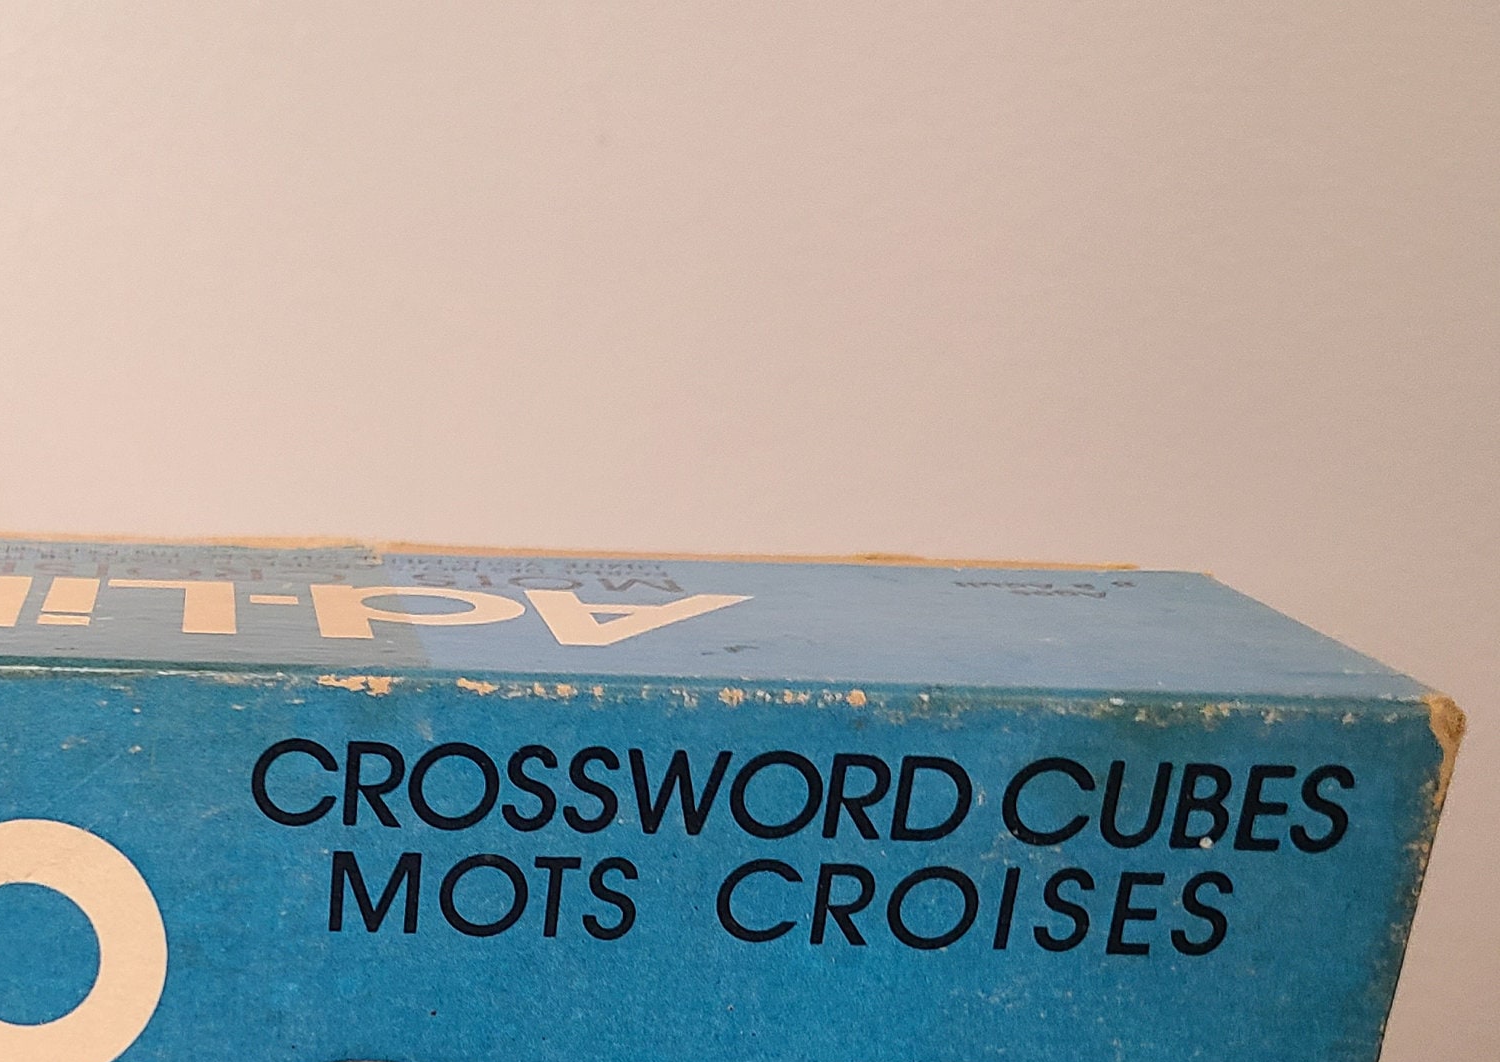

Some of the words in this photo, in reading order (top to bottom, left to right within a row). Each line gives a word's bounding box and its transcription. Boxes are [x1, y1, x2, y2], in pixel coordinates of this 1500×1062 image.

[251, 737, 973, 841] CROSSWORD
[1002, 756, 1355, 853] CUBES
[328, 851, 639, 941] MOTS
[716, 859, 1233, 956] CROISES
